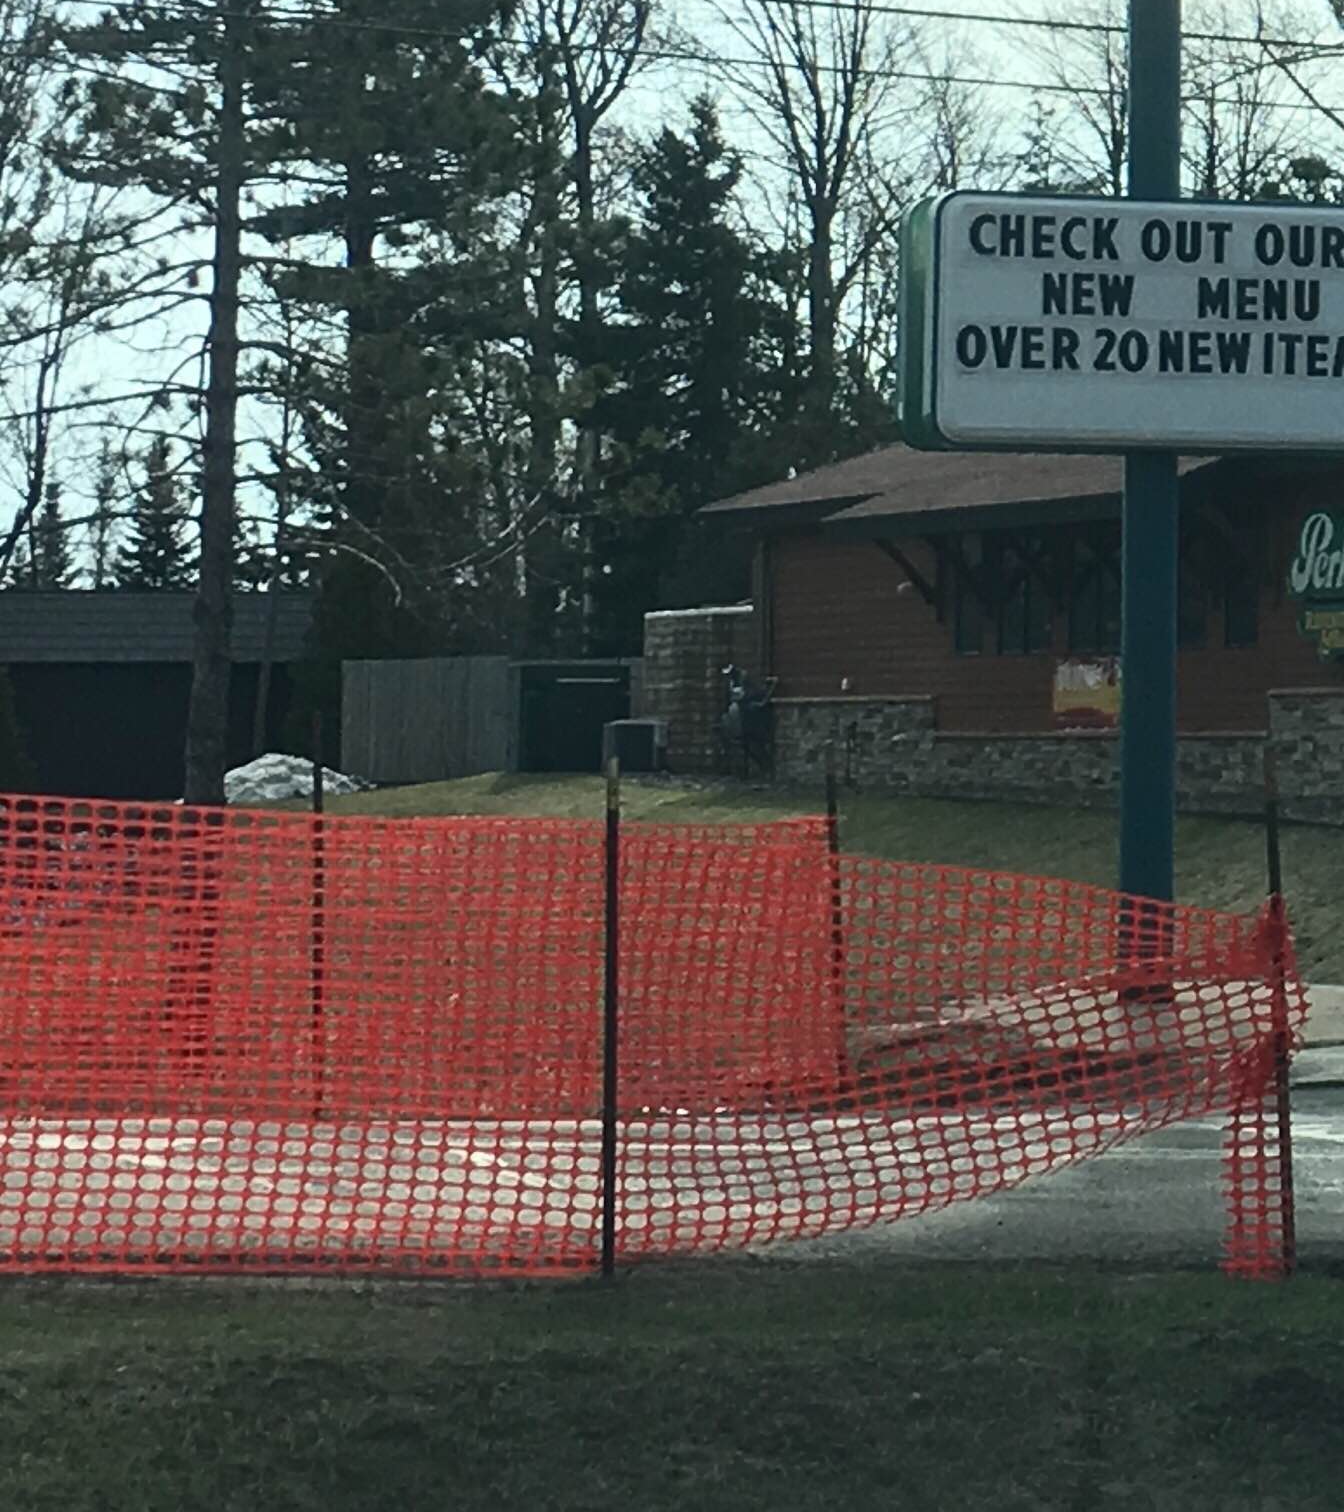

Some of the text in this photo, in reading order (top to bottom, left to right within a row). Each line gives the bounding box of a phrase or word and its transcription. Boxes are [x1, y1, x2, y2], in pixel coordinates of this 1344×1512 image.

[969, 214, 1119, 260] CHECK
[1141, 219, 1233, 263] OUT
[1042, 273, 1320, 321] NEW MENU
[955, 326, 1081, 370] OVER
[1093, 329, 1149, 372] 20
[1159, 332, 1251, 374] NEW
